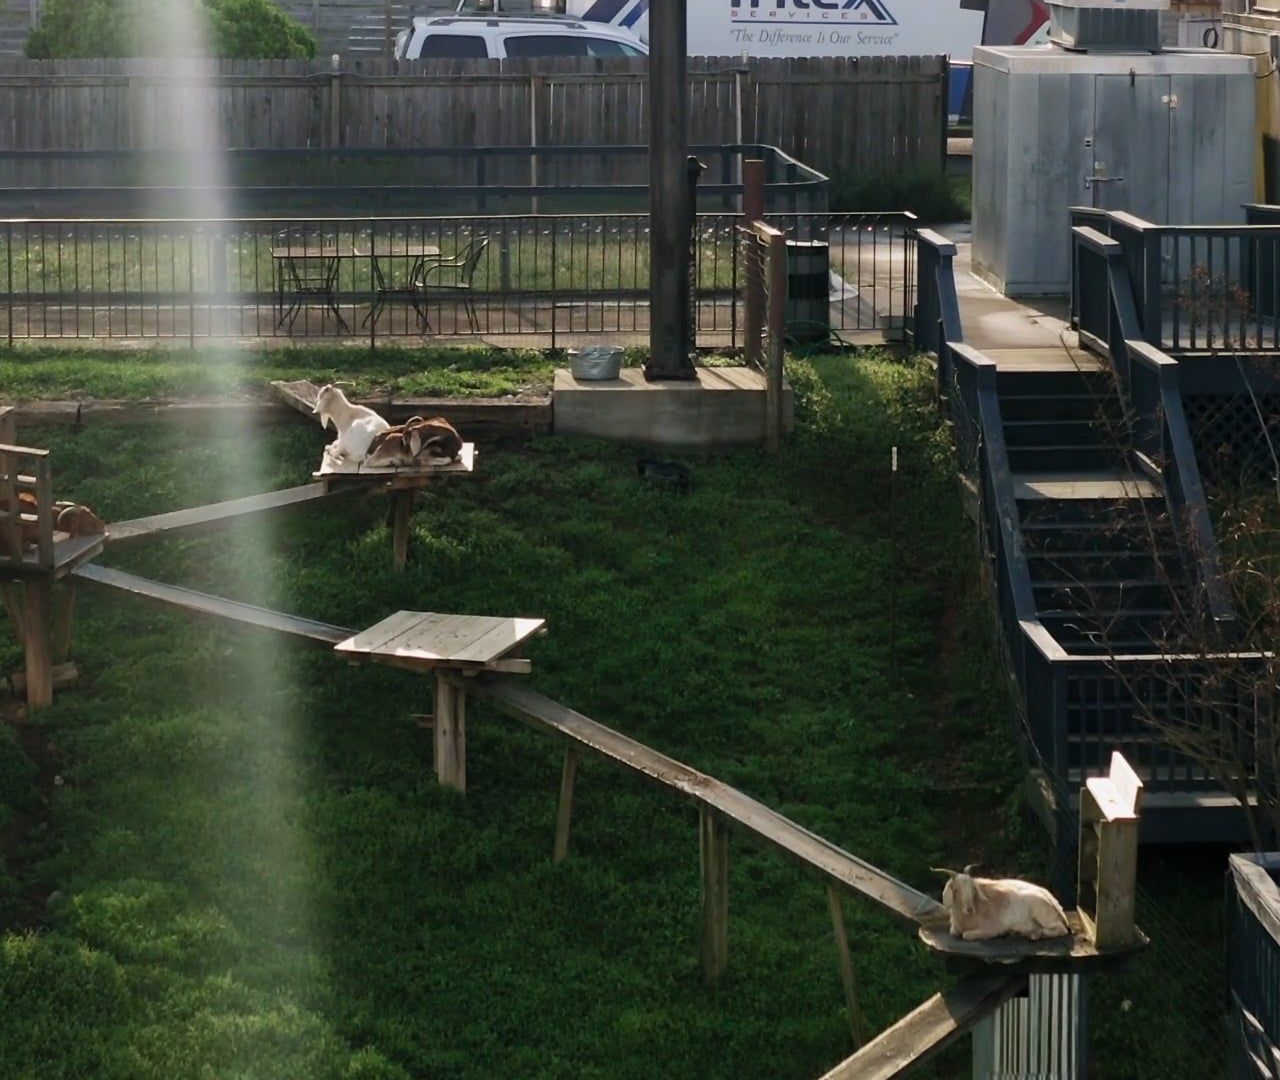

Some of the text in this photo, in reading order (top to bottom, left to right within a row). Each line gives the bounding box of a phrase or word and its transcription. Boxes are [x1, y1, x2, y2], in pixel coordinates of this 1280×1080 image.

[731, 10, 868, 19] SERVICES
[758, 28, 812, 46] Difference
[817, 30, 825, 44] Is
[829, 31, 852, 44] Our
